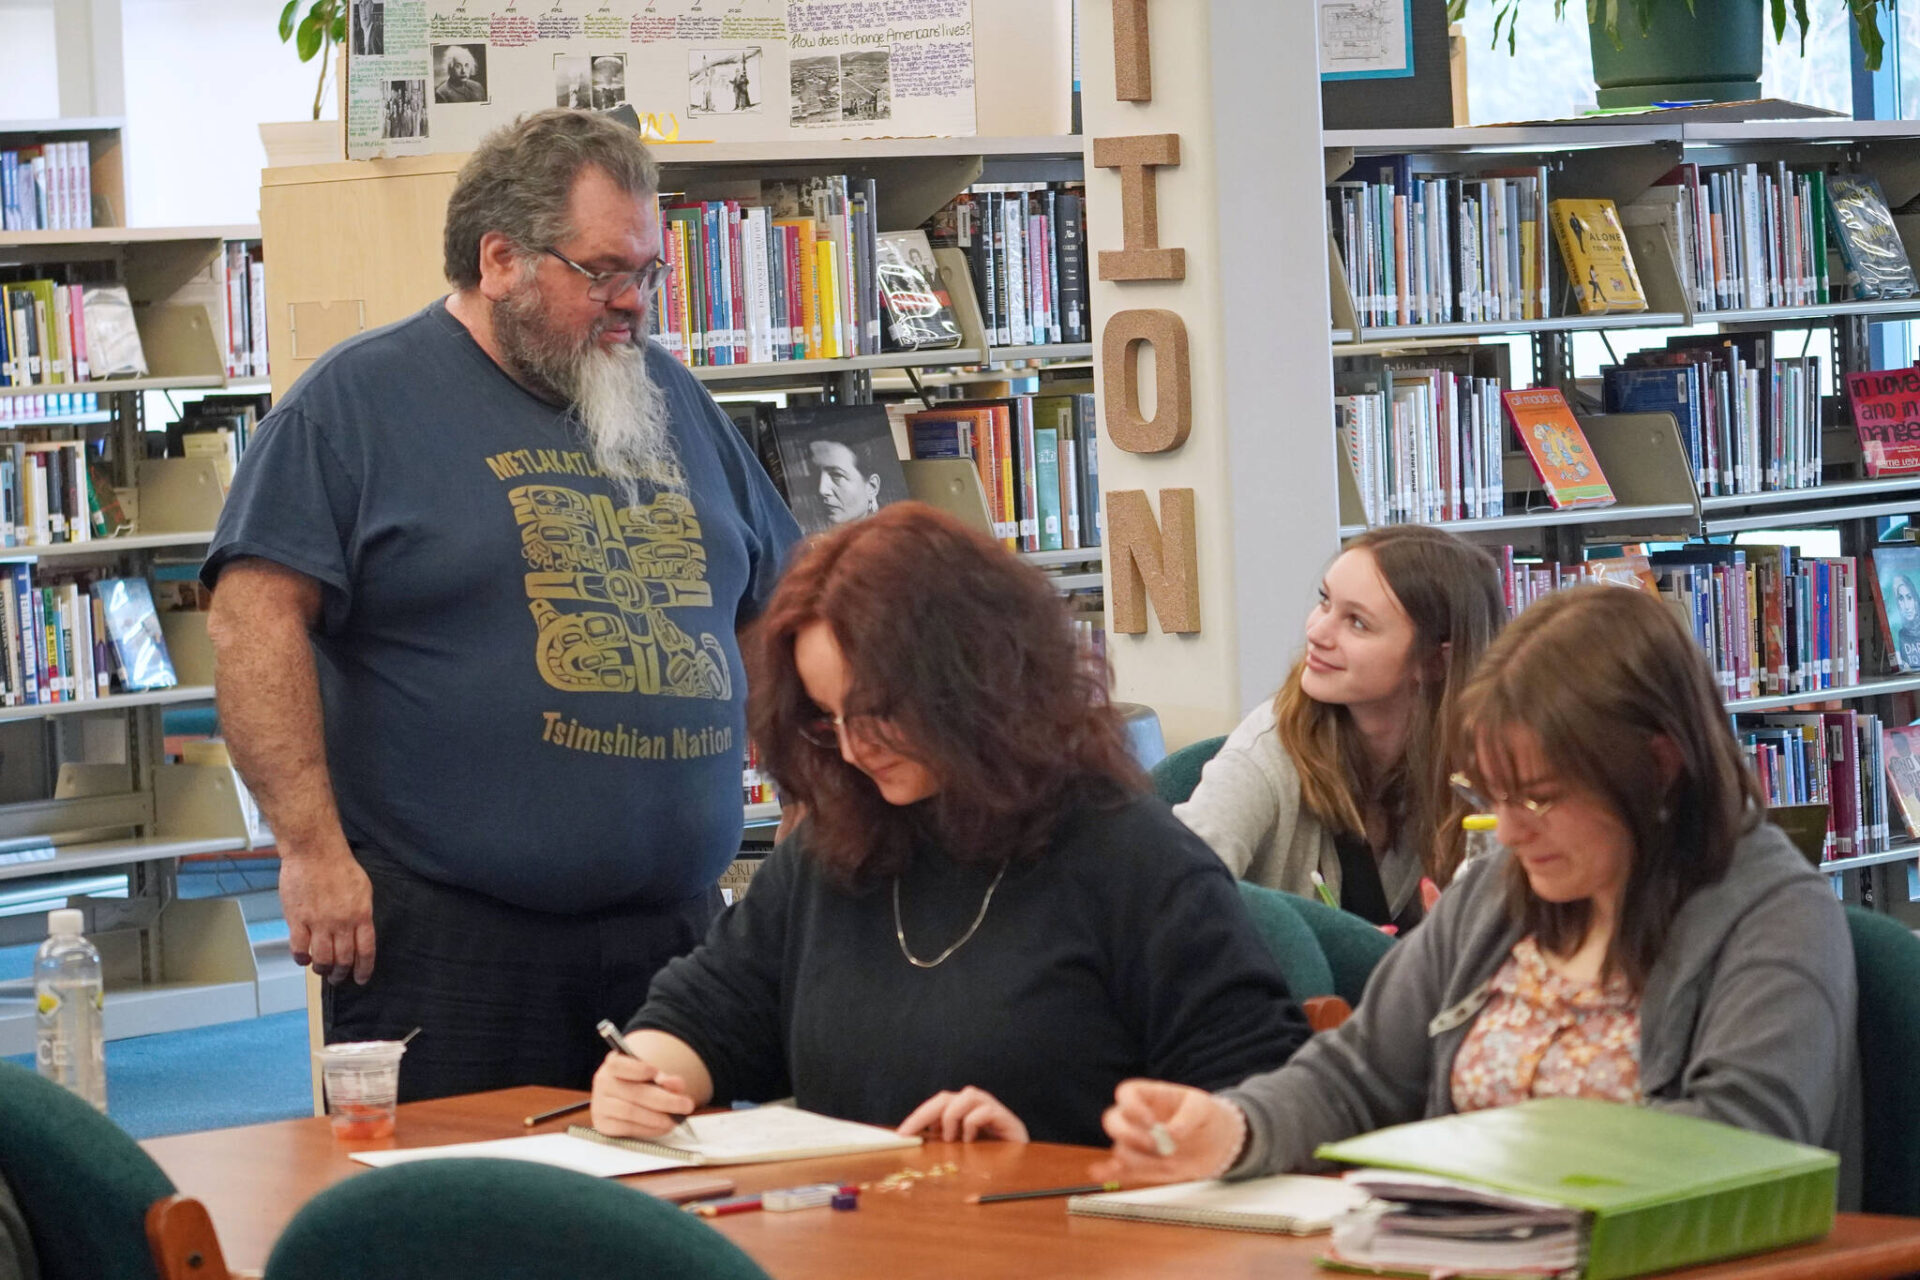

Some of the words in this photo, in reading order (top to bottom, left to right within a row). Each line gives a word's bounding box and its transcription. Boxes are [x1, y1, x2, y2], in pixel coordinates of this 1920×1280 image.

[790, 33, 815, 49] How
[818, 34, 839, 46] does
[850, 33, 885, 45] change
[887, 26, 940, 41] Americans'
[942, 21, 971, 36] lives?
[1589, 233, 1622, 241] ALONE
[1851, 378, 1869, 397] in
[1511, 393, 1523, 406] all
[1523, 392, 1549, 405] made
[1550, 392, 1562, 404] up
[1901, 400, 1918, 416] in
[484, 448, 610, 480] METLAKATL
[541, 711, 666, 760] Tsimshian
[672, 726, 732, 760] Nation
